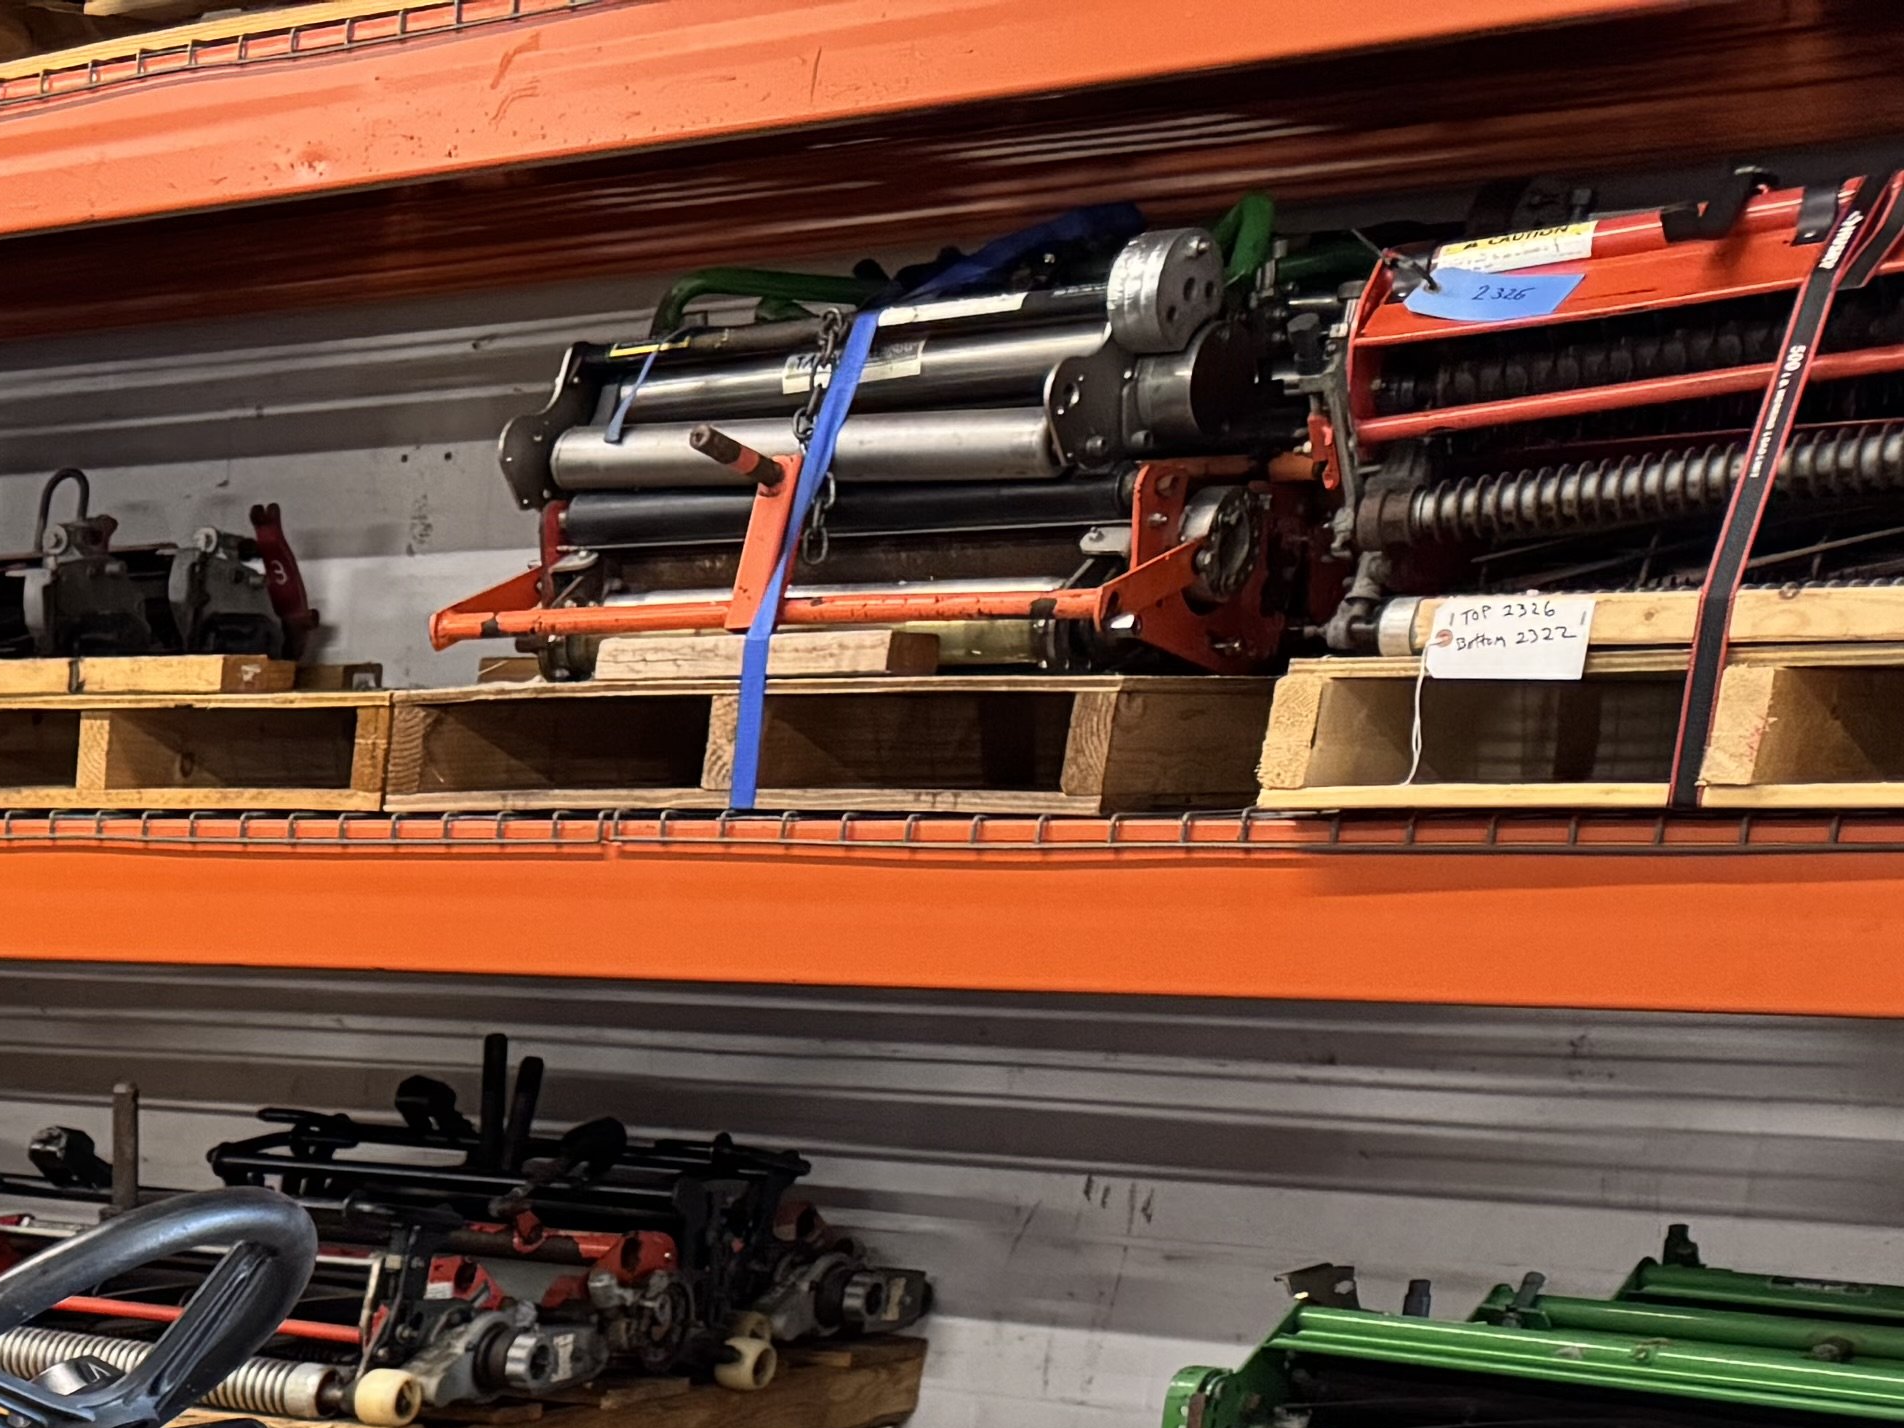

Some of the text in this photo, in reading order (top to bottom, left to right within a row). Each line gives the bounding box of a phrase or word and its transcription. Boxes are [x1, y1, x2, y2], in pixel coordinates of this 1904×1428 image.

[1460, 601, 1556, 625] TOP 2326
[1516, 626, 1578, 645] 2322
